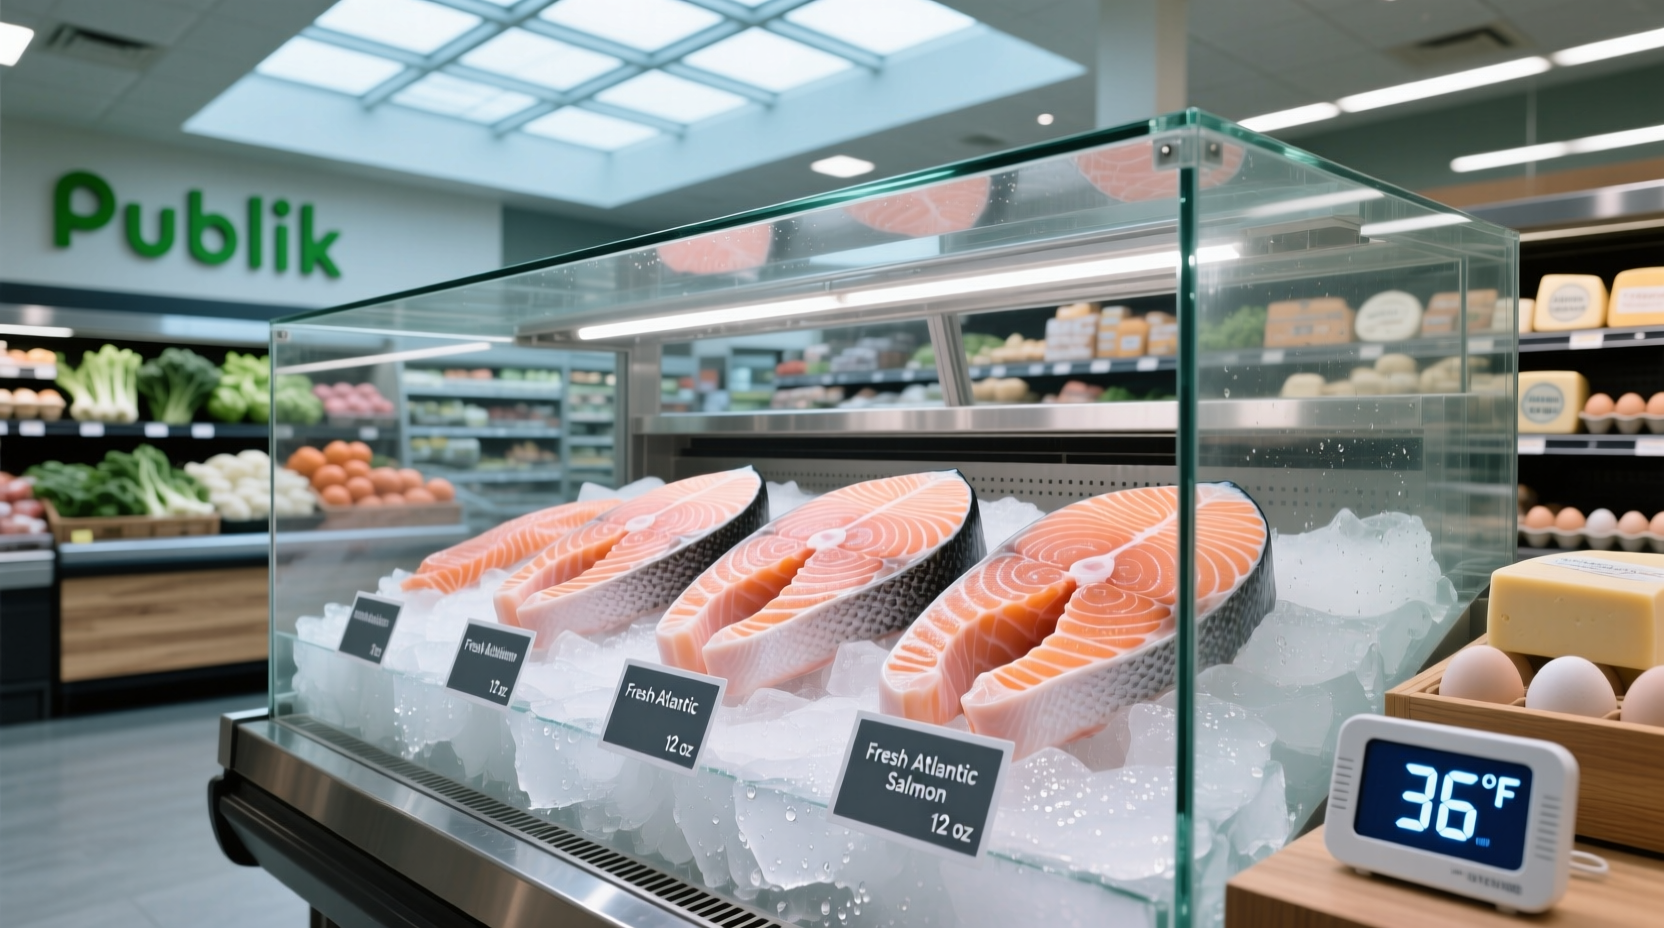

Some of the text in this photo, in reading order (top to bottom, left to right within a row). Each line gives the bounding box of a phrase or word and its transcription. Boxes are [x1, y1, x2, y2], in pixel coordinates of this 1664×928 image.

[54, 170, 341, 278] Publik
[625, 682, 655, 704] Fresh
[665, 735, 694, 758] 12 oz
[865, 742, 979, 786] Fresh Atlantic
[885, 771, 947, 804] Salmon
[930, 813, 974, 843] 12 oz
